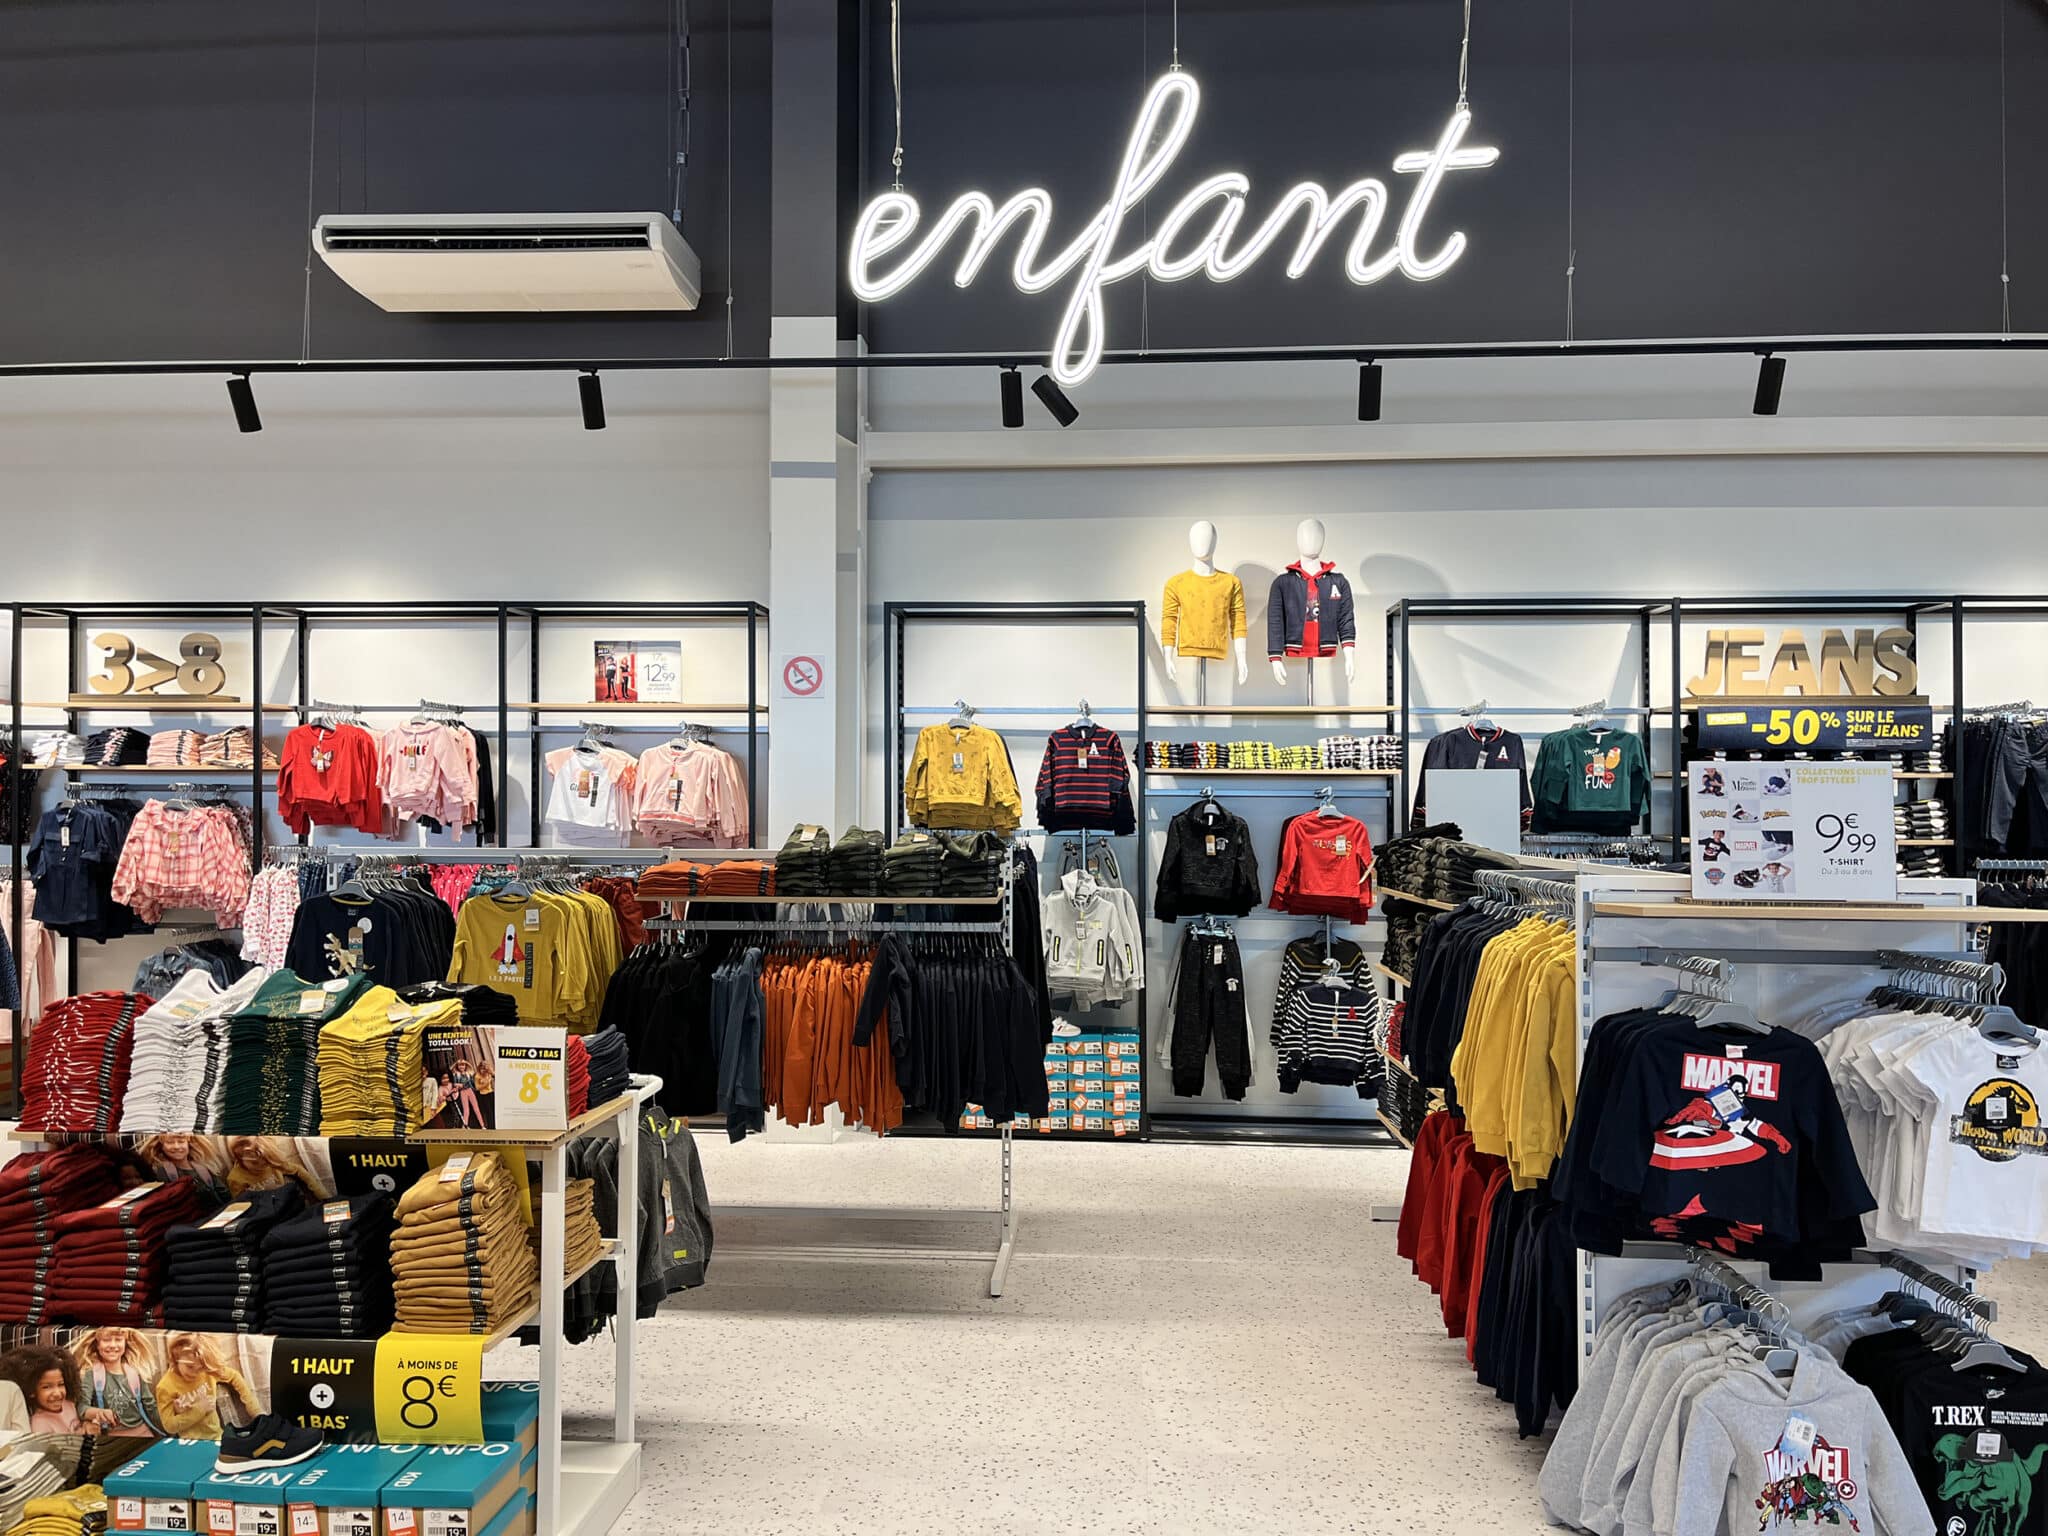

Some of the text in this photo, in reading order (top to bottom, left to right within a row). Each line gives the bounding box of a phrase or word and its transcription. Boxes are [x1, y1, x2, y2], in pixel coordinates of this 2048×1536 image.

[847, 71, 1501, 388] enfant
[1686, 628, 1918, 696] JEANS
[1846, 710, 1895, 723] SUR LE
[1751, 709, 1841, 745] -50%
[1829, 858, 1864, 866] T-SHIRT
[428, 1039, 450, 1047] TOTAL
[505, 1049, 527, 1057] HAUT
[543, 1050, 559, 1058] BAS
[514, 1063, 540, 1071] MOINS
[2003, 1127, 2047, 1147] WORLD
[348, 1154, 408, 1167] 1 HAUT
[291, 1358, 355, 1375] 1 HAUT
[407, 1360, 442, 1370] MOINS
[444, 1360, 458, 1370] DE
[297, 1415, 306, 1429] 1
[1931, 1405, 1985, 1426] T.REX
[118, 1460, 150, 1477] KID
[298, 1469, 328, 1486] KID
[394, 1471, 422, 1488] KID
